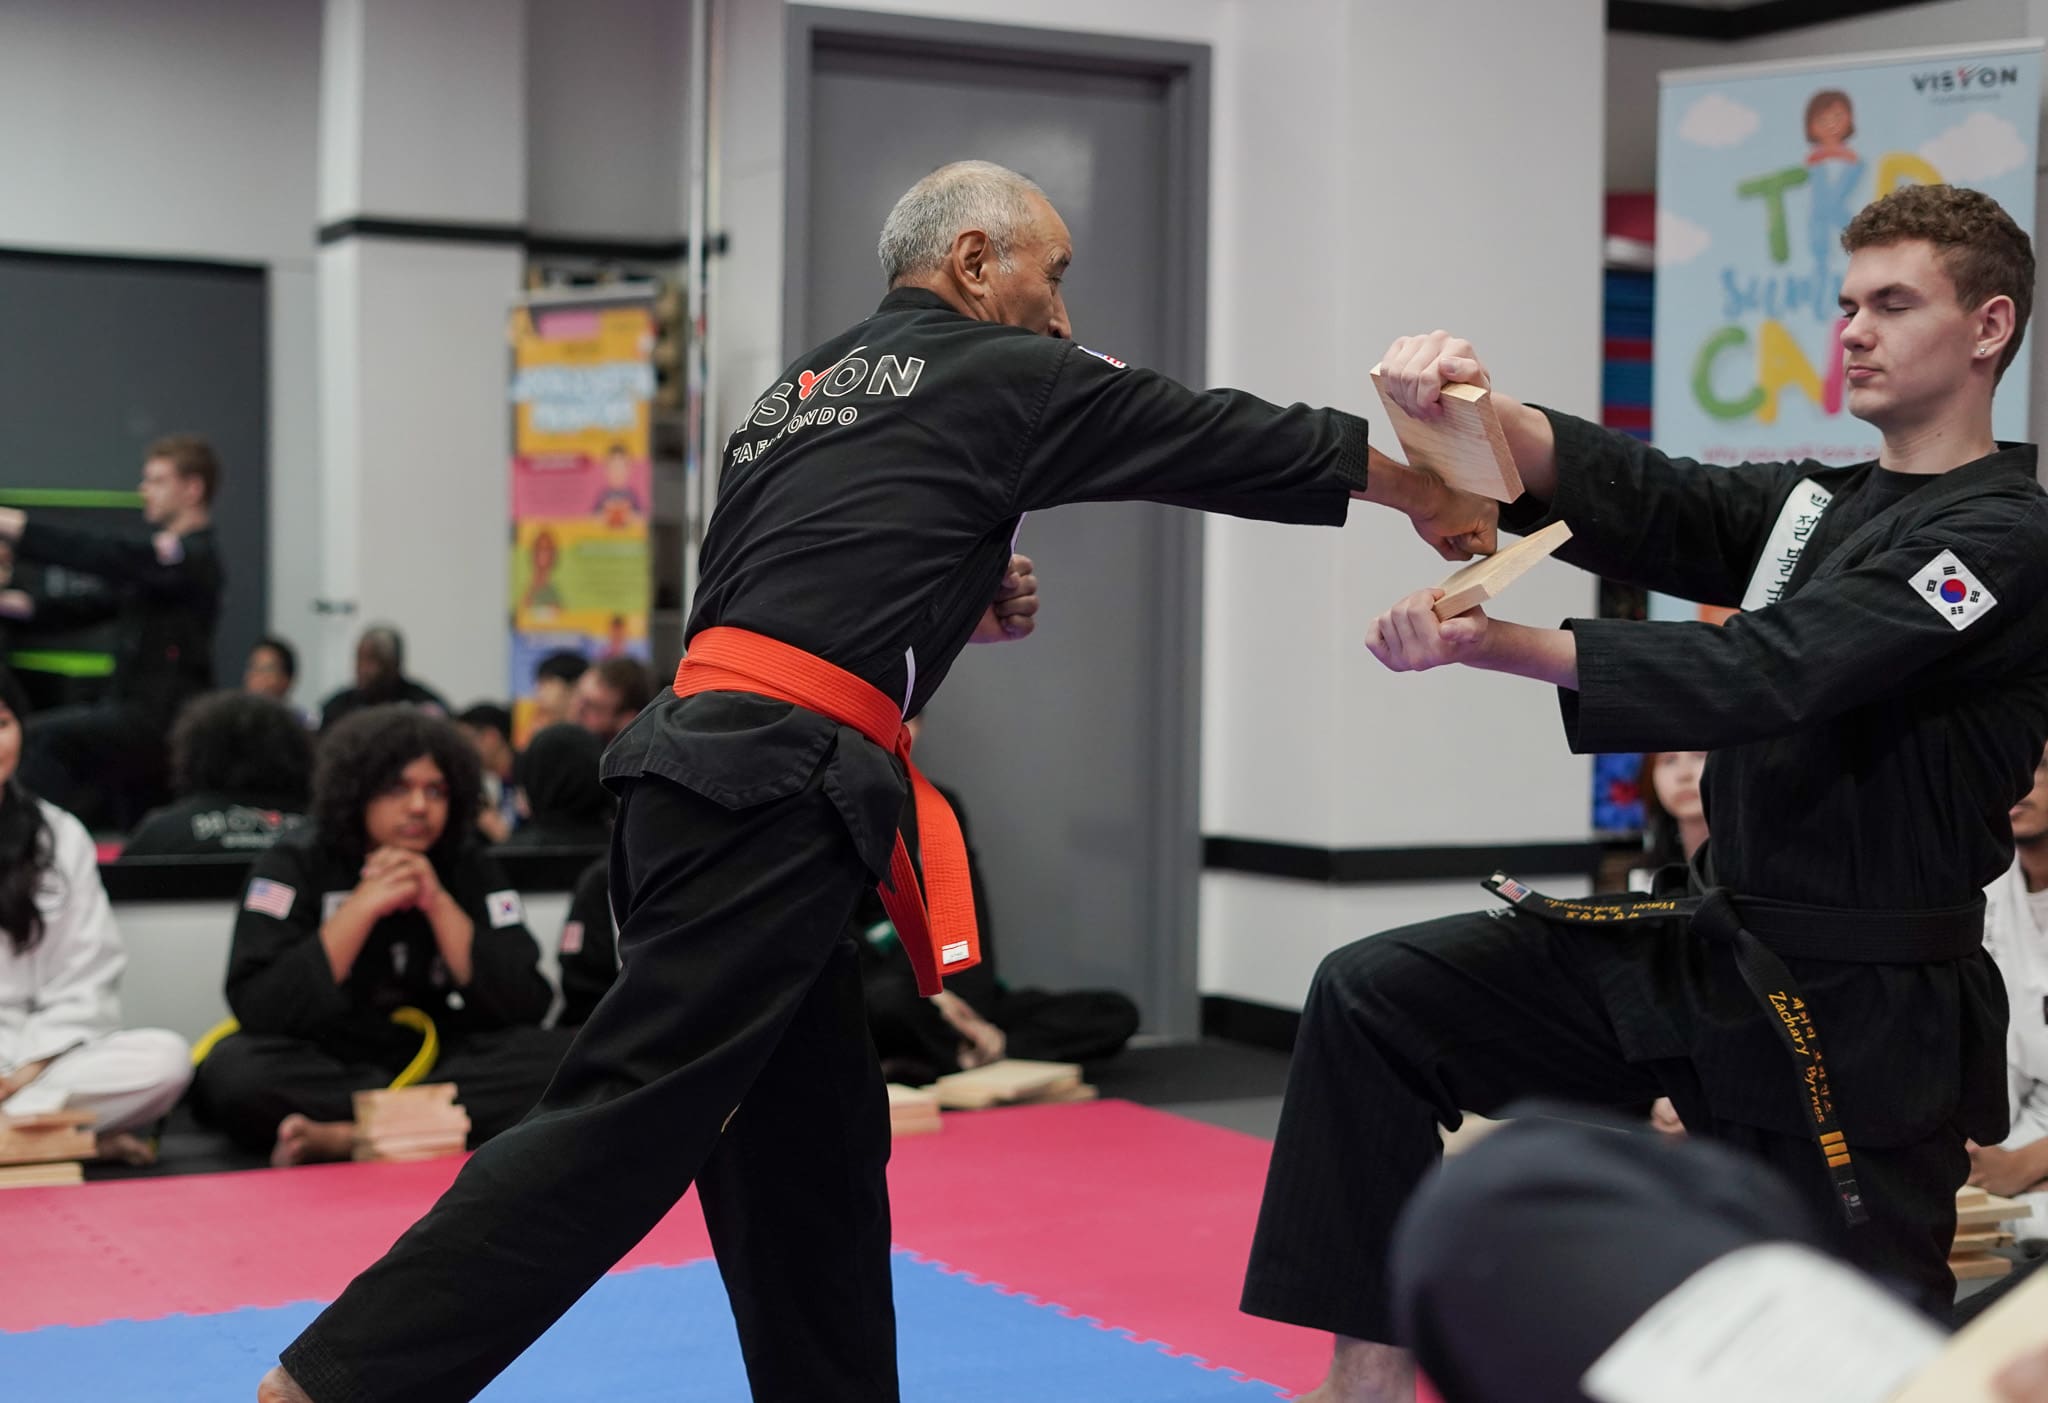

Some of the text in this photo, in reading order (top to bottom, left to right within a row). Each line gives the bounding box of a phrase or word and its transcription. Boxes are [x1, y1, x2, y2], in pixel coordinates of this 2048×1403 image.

[731, 407, 858, 467] TAEONDO
[1768, 991, 1825, 1123] Zachary Byrnes
